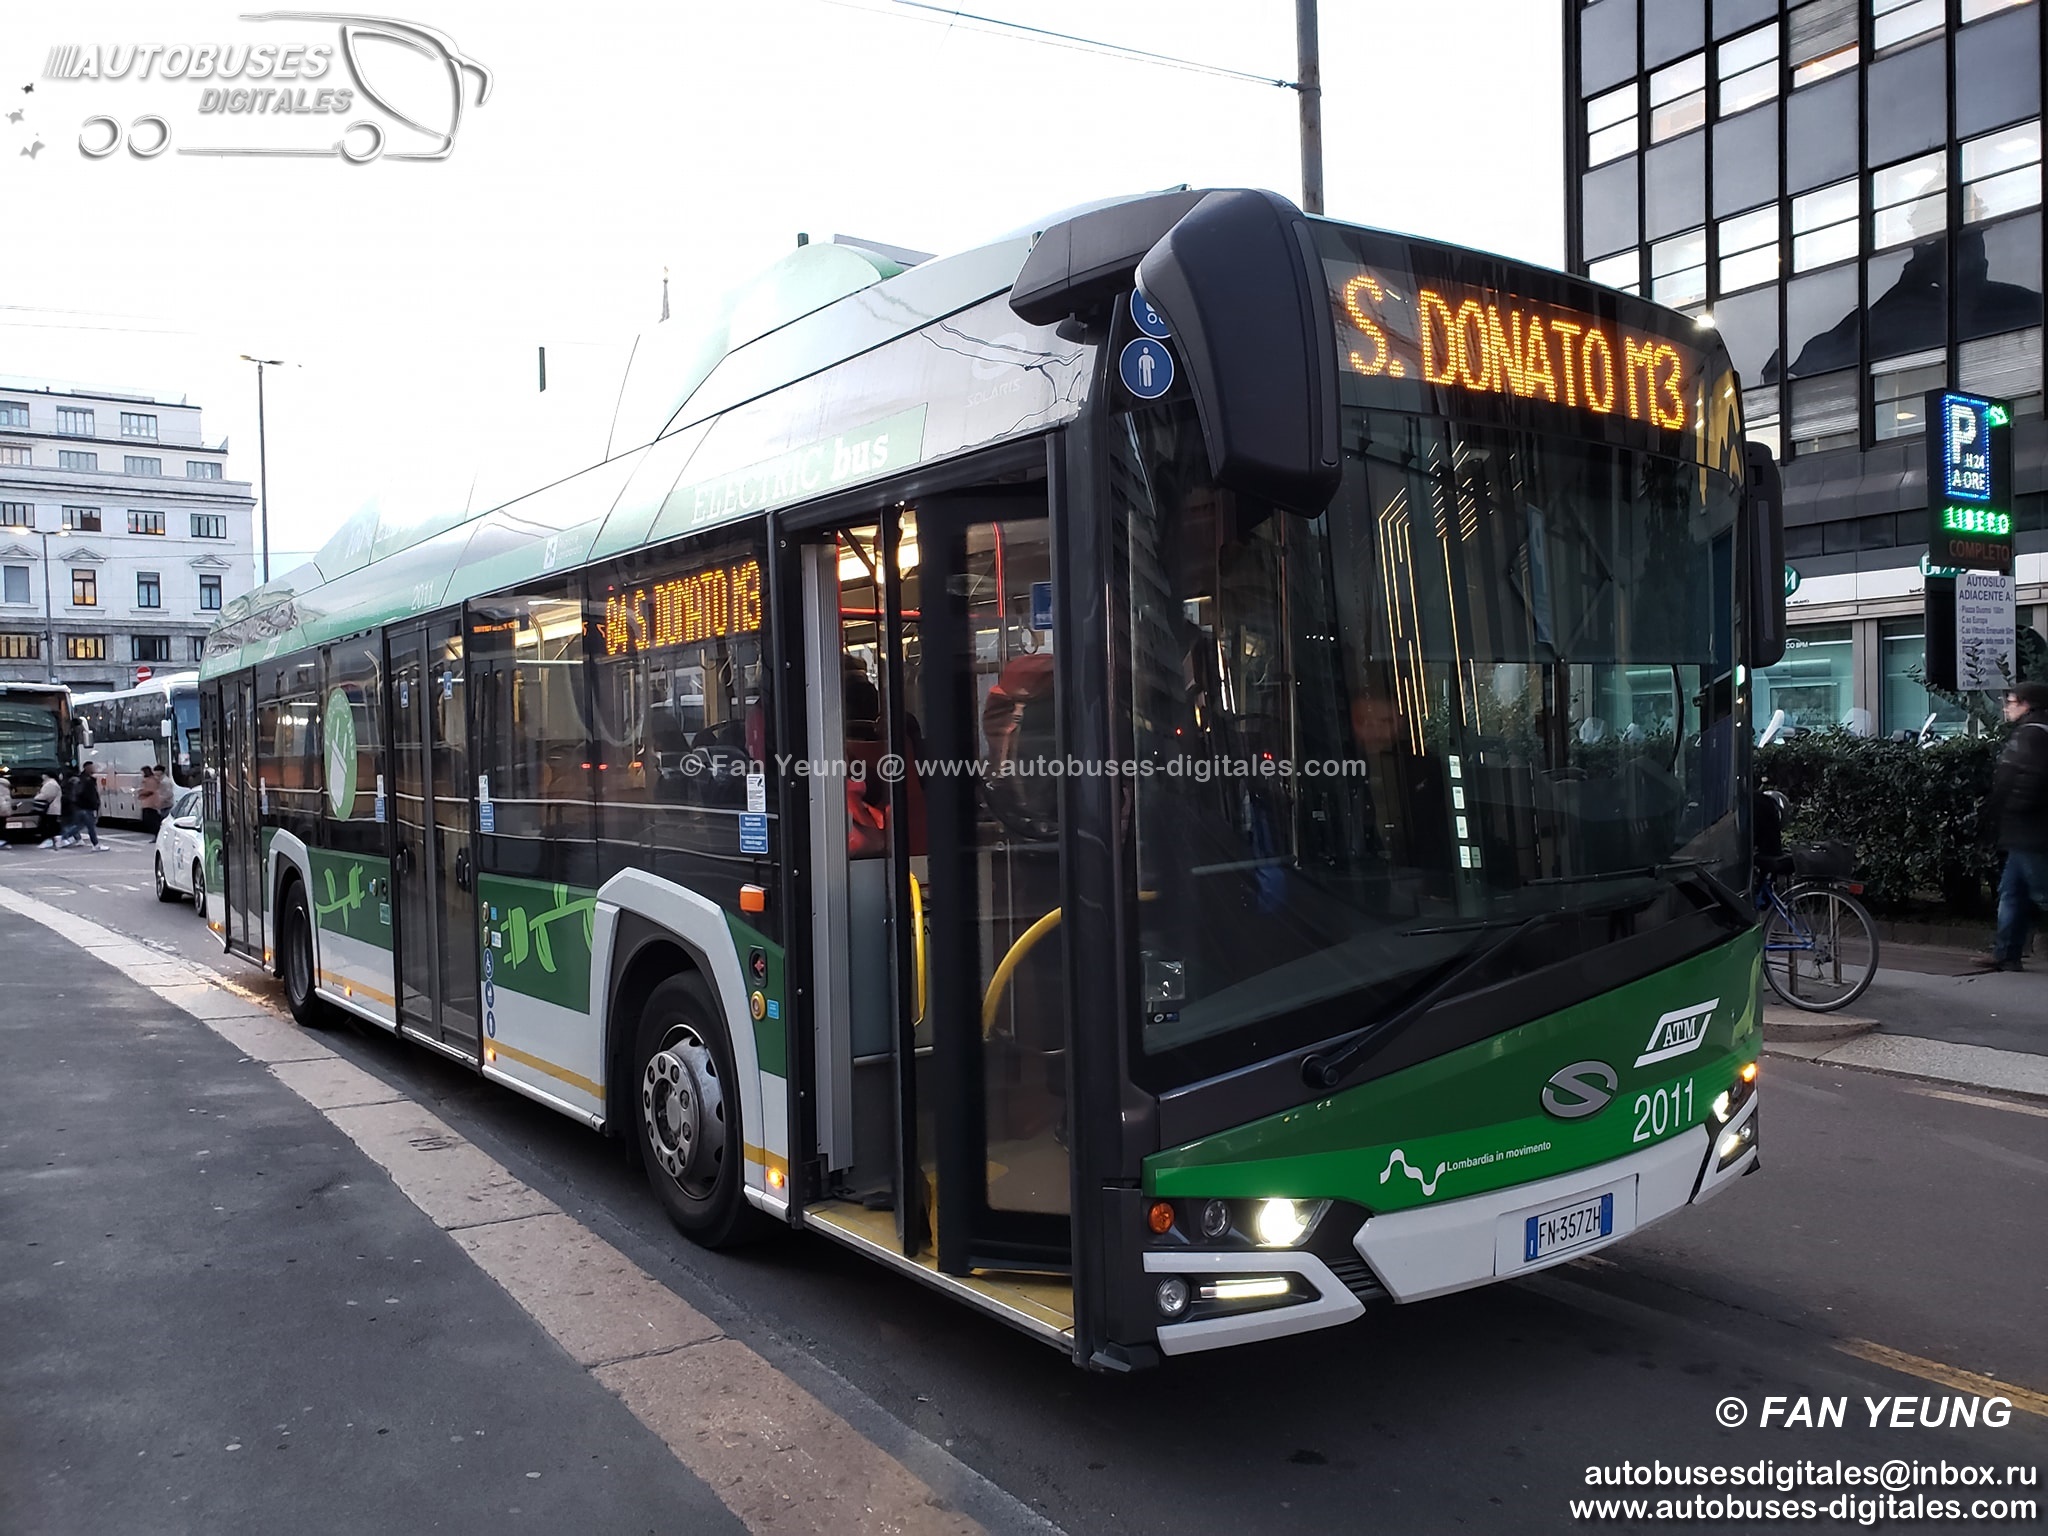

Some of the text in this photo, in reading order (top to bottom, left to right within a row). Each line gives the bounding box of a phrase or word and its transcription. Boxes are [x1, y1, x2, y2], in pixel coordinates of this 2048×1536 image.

[1419, 288, 1614, 414] DONATO
[1625, 336, 1685, 430] M3
[965, 378, 1021, 408] SOLARIS
[1950, 404, 1976, 465] P
[691, 432, 889, 525] ELECTRIC bus
[1950, 540, 2010, 562] COMPLETO
[1959, 590, 2004, 601] ADIACENTE
[1966, 576, 2006, 588] AUTOSILO
[411, 584, 434, 611] 2011
[654, 569, 728, 647] DONATO
[732, 560, 762, 633] M3
[1663, 1019, 1697, 1049] ATM
[1633, 1078, 1694, 1143] 2011
[1447, 1141, 1552, 1172] Lombardia in movimento
